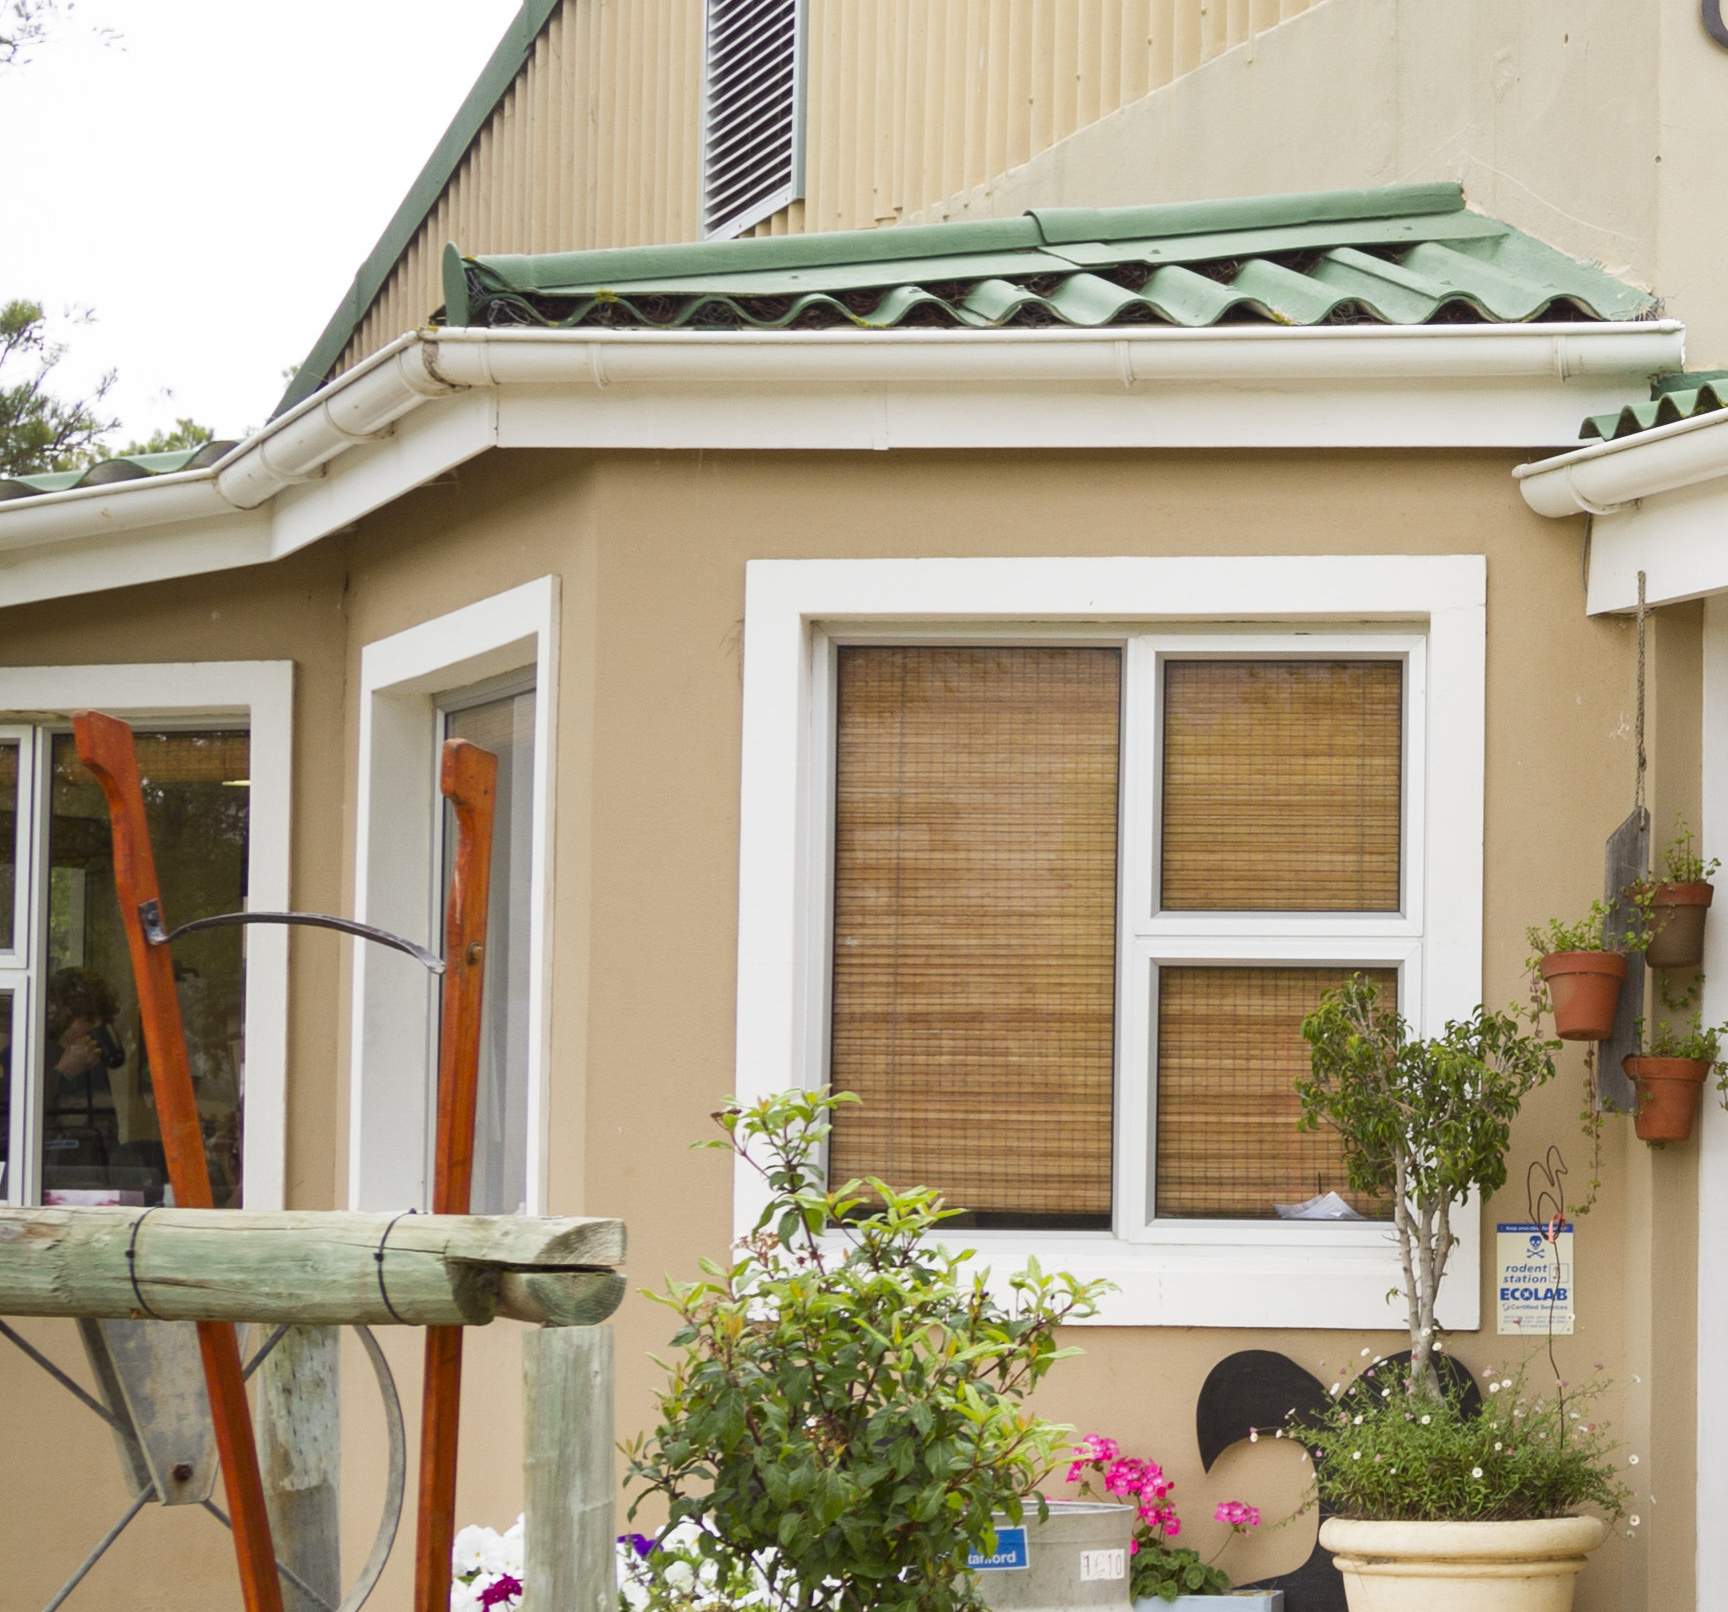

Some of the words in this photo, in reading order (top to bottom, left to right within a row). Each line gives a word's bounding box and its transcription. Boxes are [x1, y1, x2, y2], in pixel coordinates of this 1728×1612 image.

[1505, 1263, 1548, 1273] rodent
[1503, 1274, 1548, 1283] station
[1500, 1287, 1568, 1301] ECOLAB
